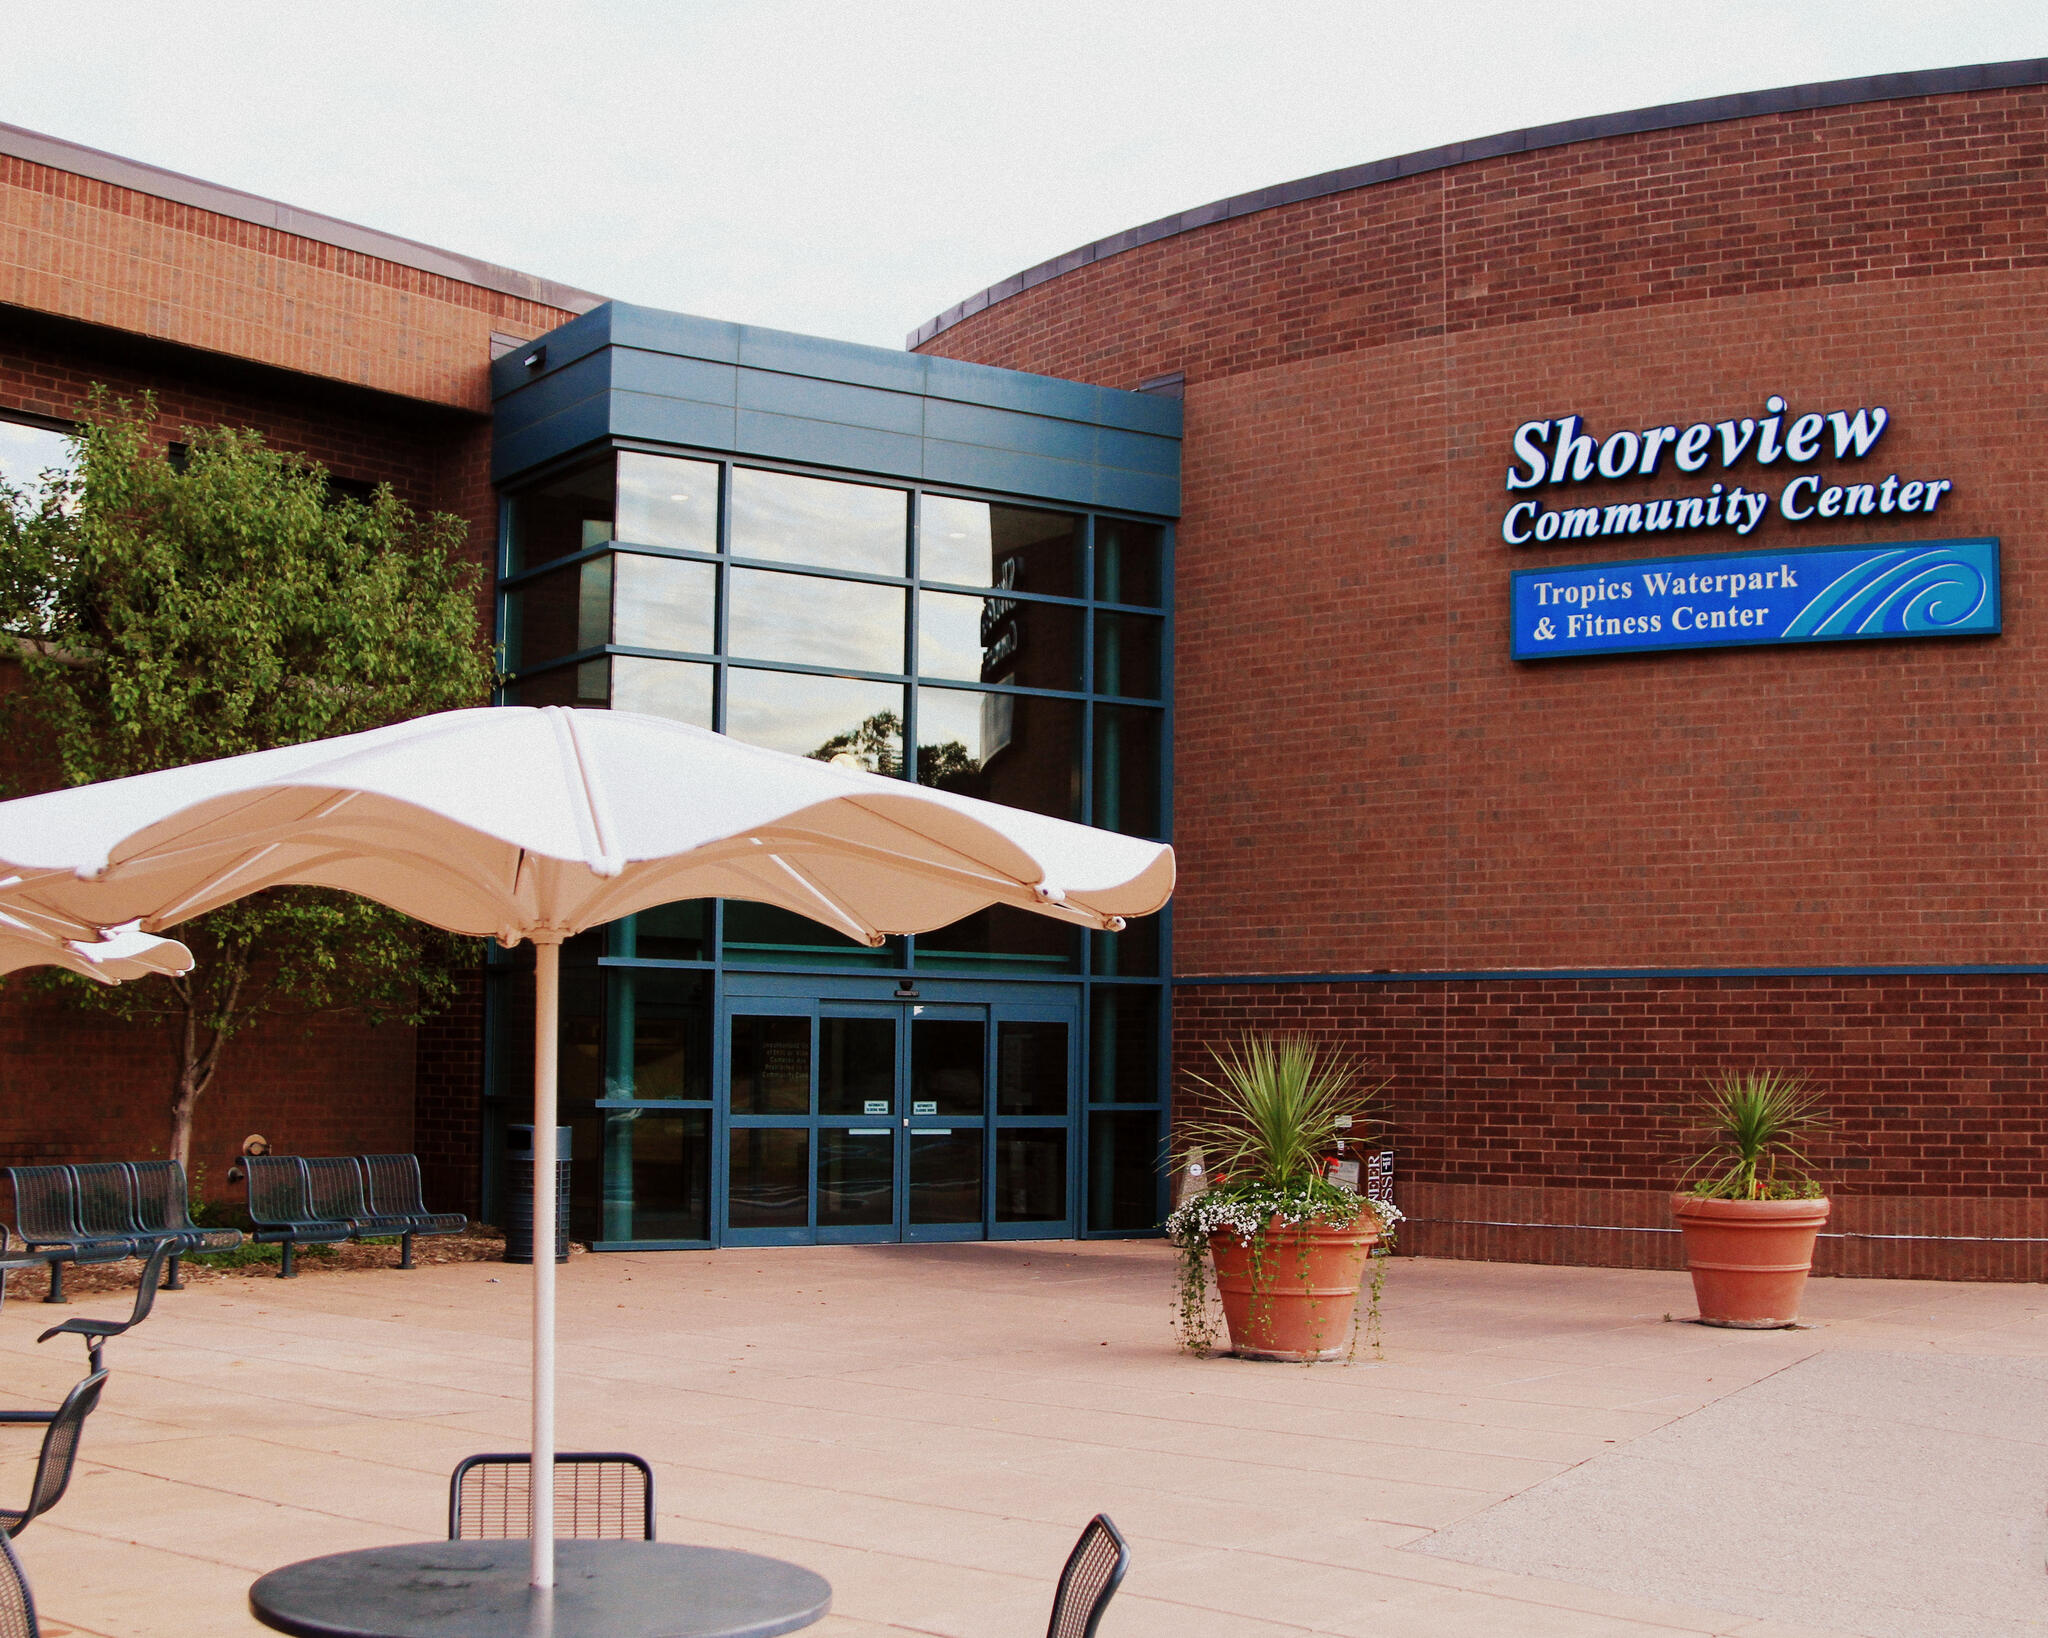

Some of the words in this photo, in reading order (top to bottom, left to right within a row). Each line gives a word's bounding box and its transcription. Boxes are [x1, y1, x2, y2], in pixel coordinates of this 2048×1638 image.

[1506, 394, 1889, 490] Shoreview
[1501, 483, 1769, 544] Community
[1780, 474, 1952, 521] Center
[1534, 577, 1632, 609] Tropics
[1642, 564, 1799, 598] Waterpark
[1533, 616, 1556, 641] &
[1566, 613, 1662, 639] Fitness
[1671, 606, 1769, 631] Center
